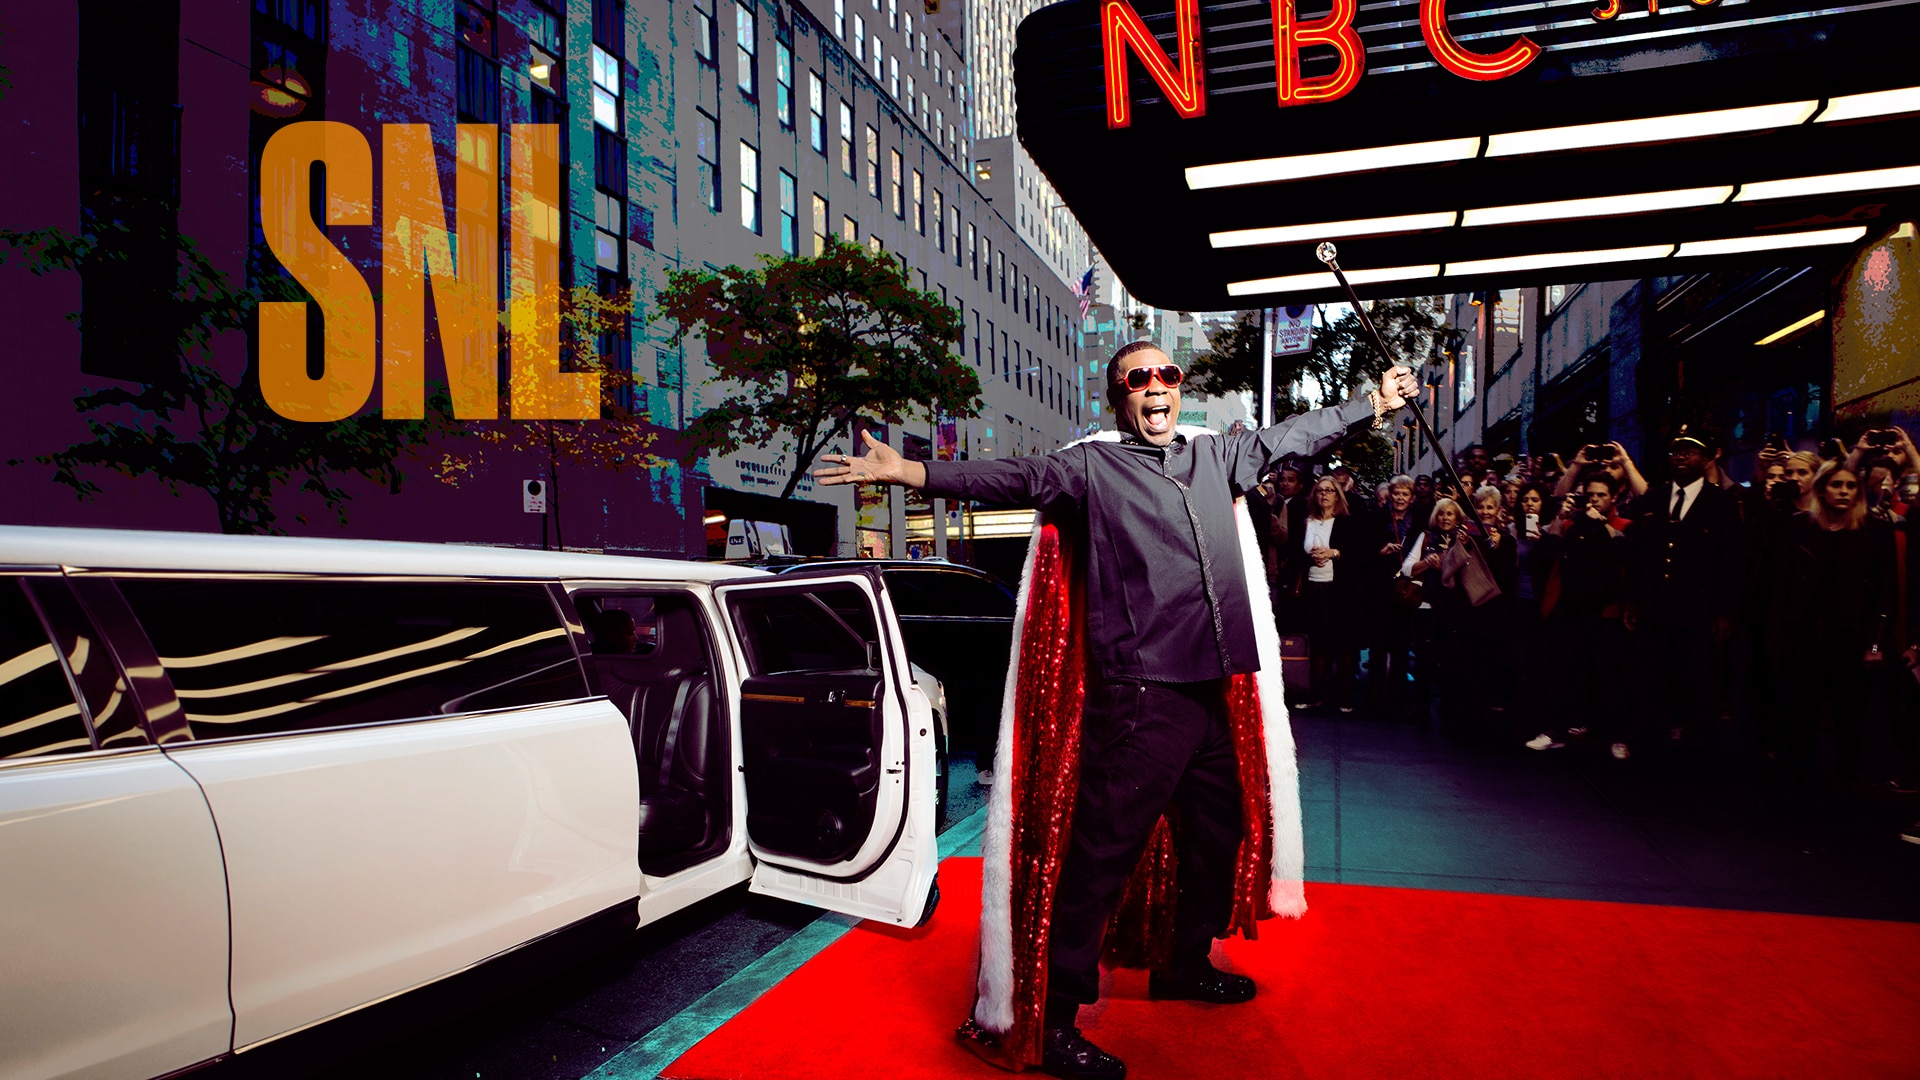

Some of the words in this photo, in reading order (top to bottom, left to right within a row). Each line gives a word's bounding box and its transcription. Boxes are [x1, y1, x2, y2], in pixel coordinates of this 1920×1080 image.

[1101, 0, 1542, 129] NBC
[1289, 319, 1301, 328] NO
[1279, 326, 1309, 338] STANDING
